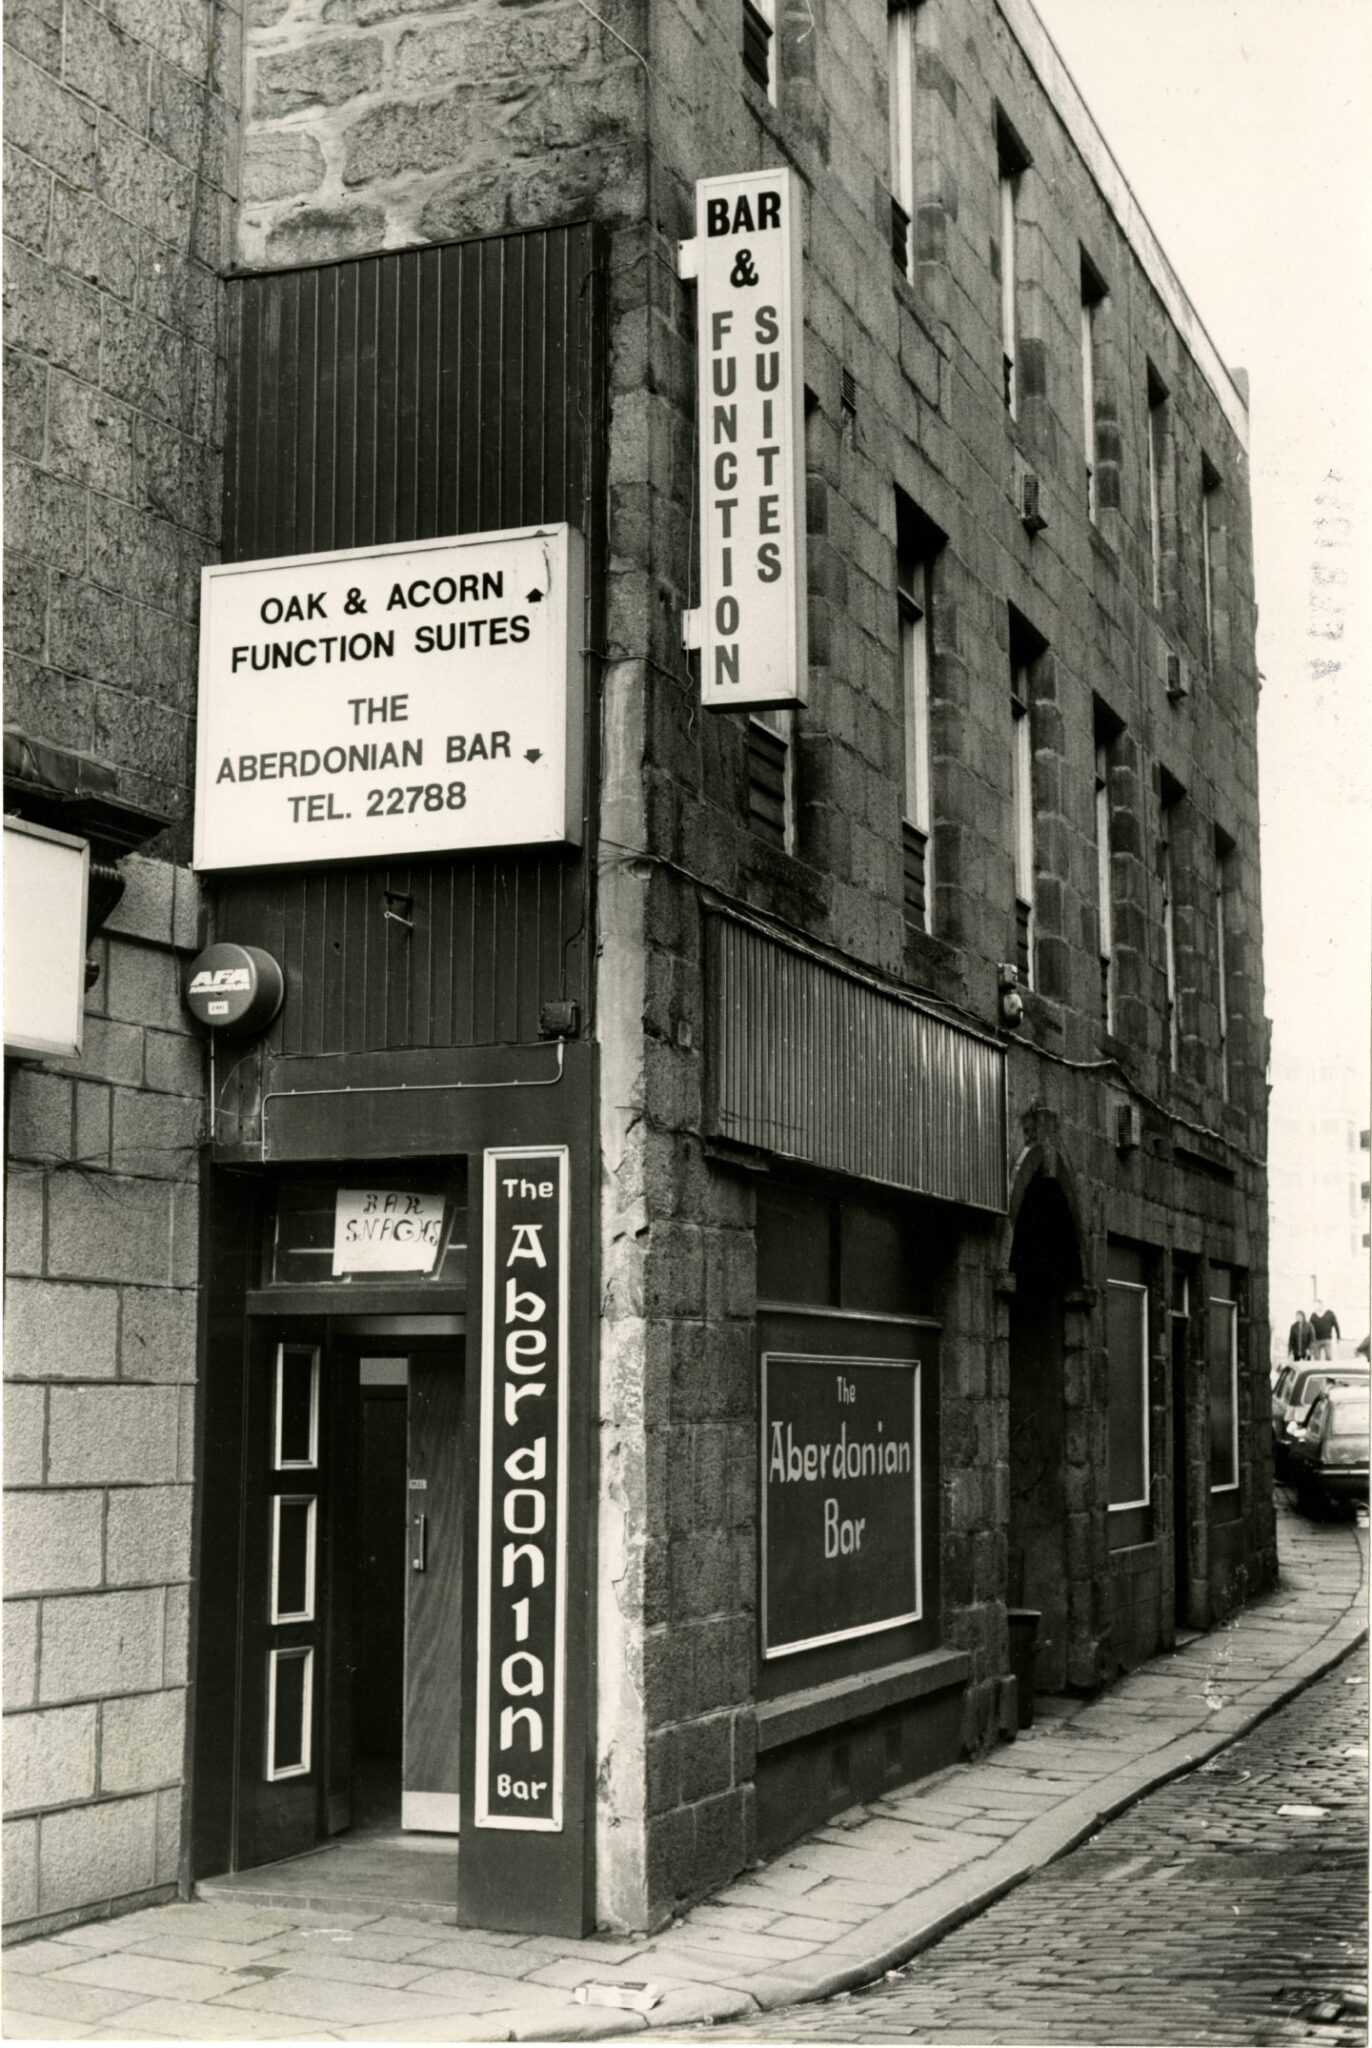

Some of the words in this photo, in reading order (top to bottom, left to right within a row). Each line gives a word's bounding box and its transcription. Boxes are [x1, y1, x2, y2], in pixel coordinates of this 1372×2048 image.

[706, 191, 782, 239] BAR
[730, 249, 760, 289] &
[755, 306, 782, 583] SUITES
[712, 311, 740, 686] FUNCTION
[260, 591, 328, 625] OAK
[343, 587, 368, 616] &
[386, 571, 504, 611] ACORN
[232, 630, 395, 673] FUNCTION
[415, 615, 531, 653] SUITES
[348, 694, 409, 726] THE
[216, 739, 424, 784] ABERDONIAN
[446, 731, 512, 764] BAR
[288, 793, 352, 823] TEL.
[366, 782, 467, 818] 22788
[189, 968, 250, 988] AFA
[363, 1193, 425, 1214] BAR
[502, 1179, 554, 1200] The
[836, 1376, 856, 1404] The
[769, 1421, 911, 1483] Aberdonian
[500, 1225, 547, 1752] Aberdonian
[824, 1498, 866, 1558] Bar
[497, 1773, 548, 1801] Bar
